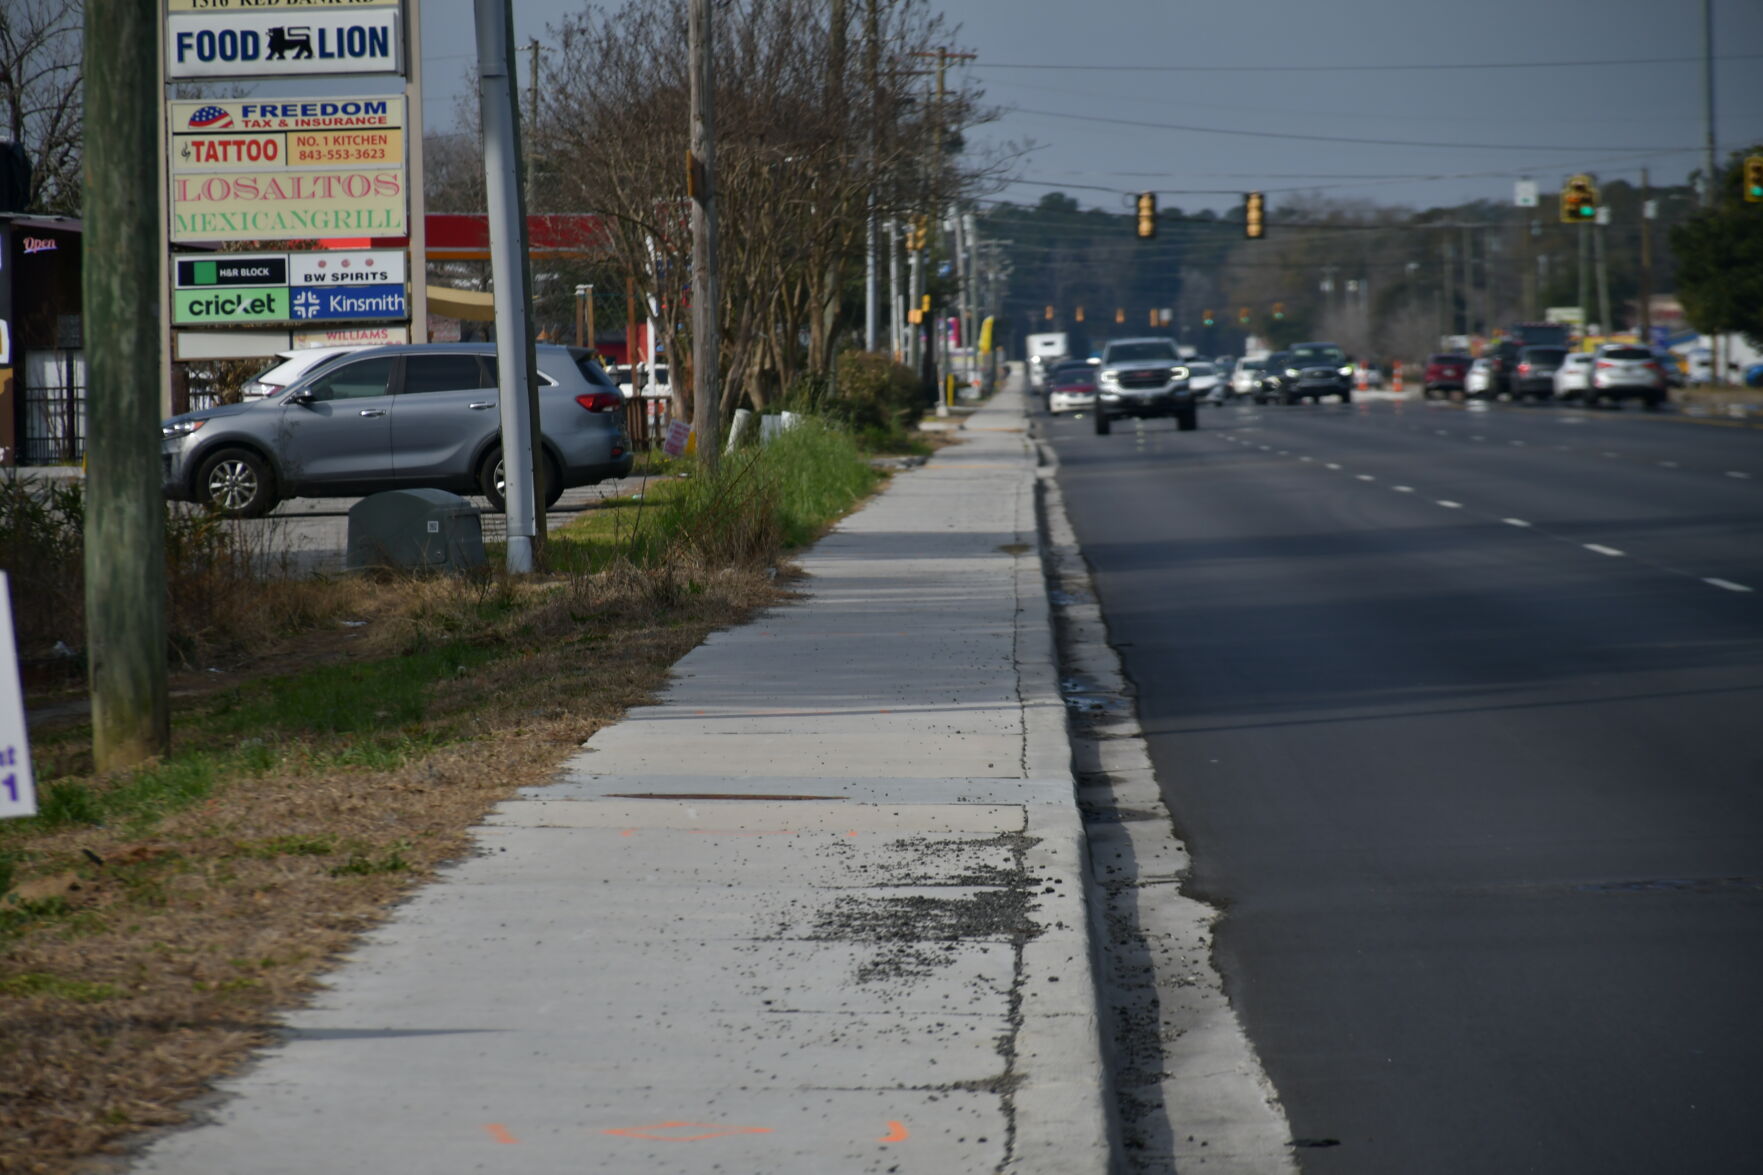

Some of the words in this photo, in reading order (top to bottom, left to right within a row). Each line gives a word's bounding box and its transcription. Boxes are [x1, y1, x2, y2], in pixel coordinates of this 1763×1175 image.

[177, 29, 260, 63] FOOD
[318, 26, 389, 59] LION
[242, 101, 387, 118] FREEDOM
[242, 119, 273, 129] TAX
[278, 118, 289, 128] &
[295, 116, 388, 127] INSURANCE
[297, 136, 320, 147] NO.
[323, 136, 328, 146] 1
[333, 135, 388, 146] KITCHEN
[191, 139, 278, 163] TATTOO
[299, 149, 385, 160] 843-553-3623
[23, 236, 57, 254] Open
[220, 268, 239, 277] H&R
[240, 267, 270, 276] BLOCK
[304, 273, 326, 282] BW
[331, 271, 388, 281] SPIRITS
[188, 293, 276, 316] cricket
[329, 293, 405, 312] Kinsmith
[326, 328, 388, 340] WILLIAMS
